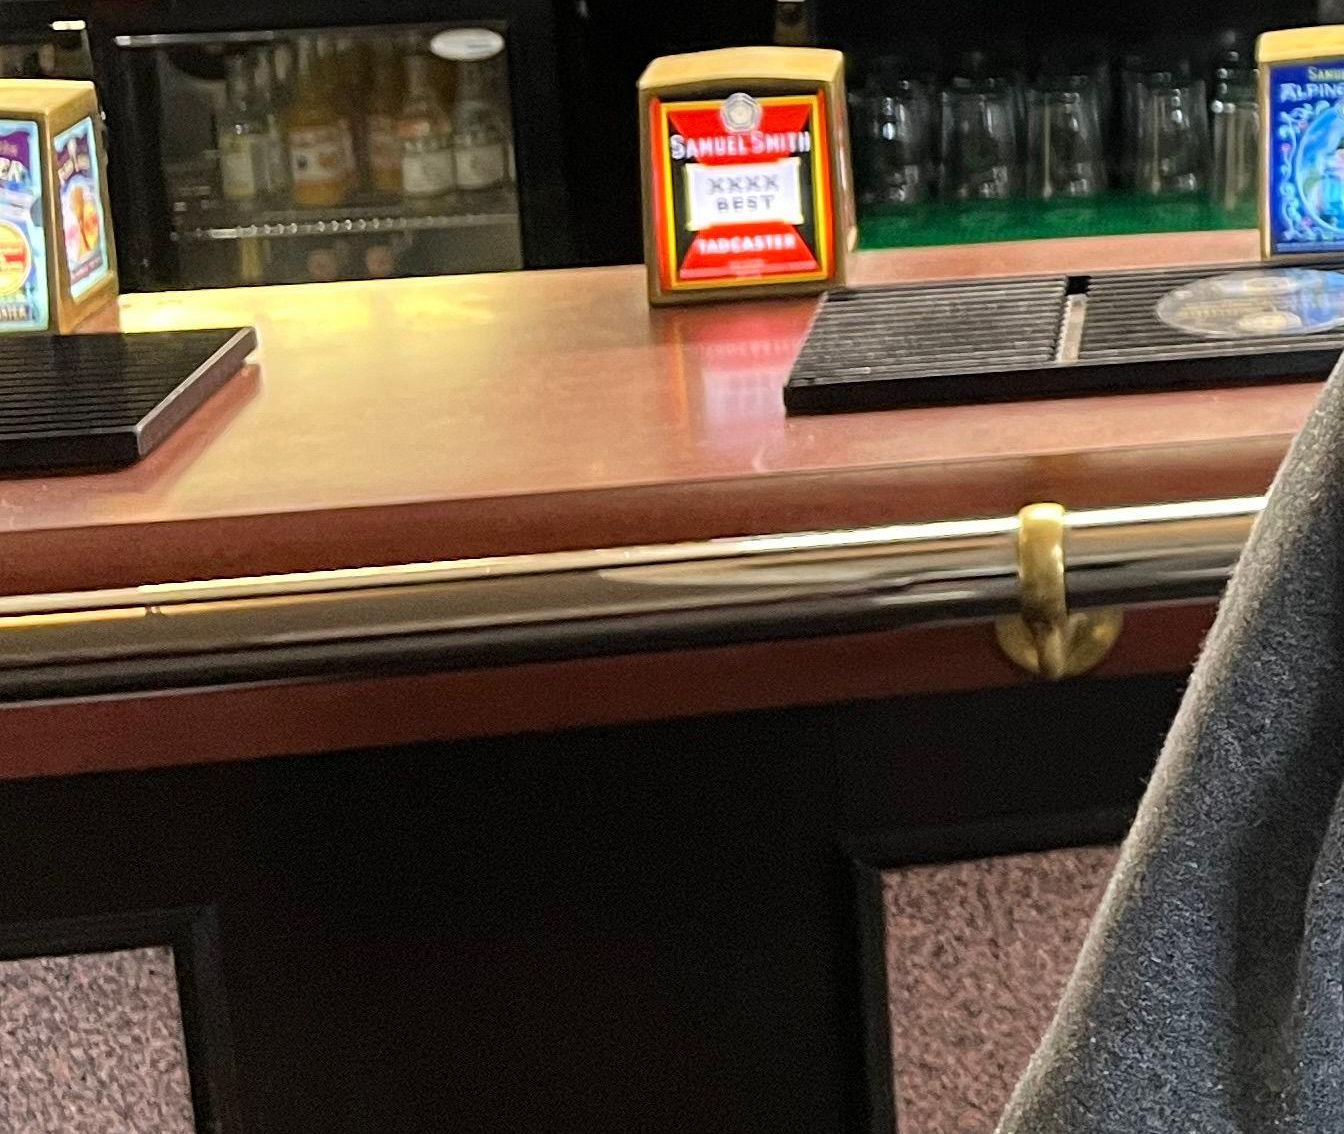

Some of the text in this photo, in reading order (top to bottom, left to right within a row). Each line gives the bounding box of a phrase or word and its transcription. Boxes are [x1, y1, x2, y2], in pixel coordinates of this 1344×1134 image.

[669, 130, 811, 160] SAMUEL SMITH
[706, 174, 780, 196] XXXX
[717, 194, 775, 212] BEST
[697, 234, 797, 255] TADCASTER
